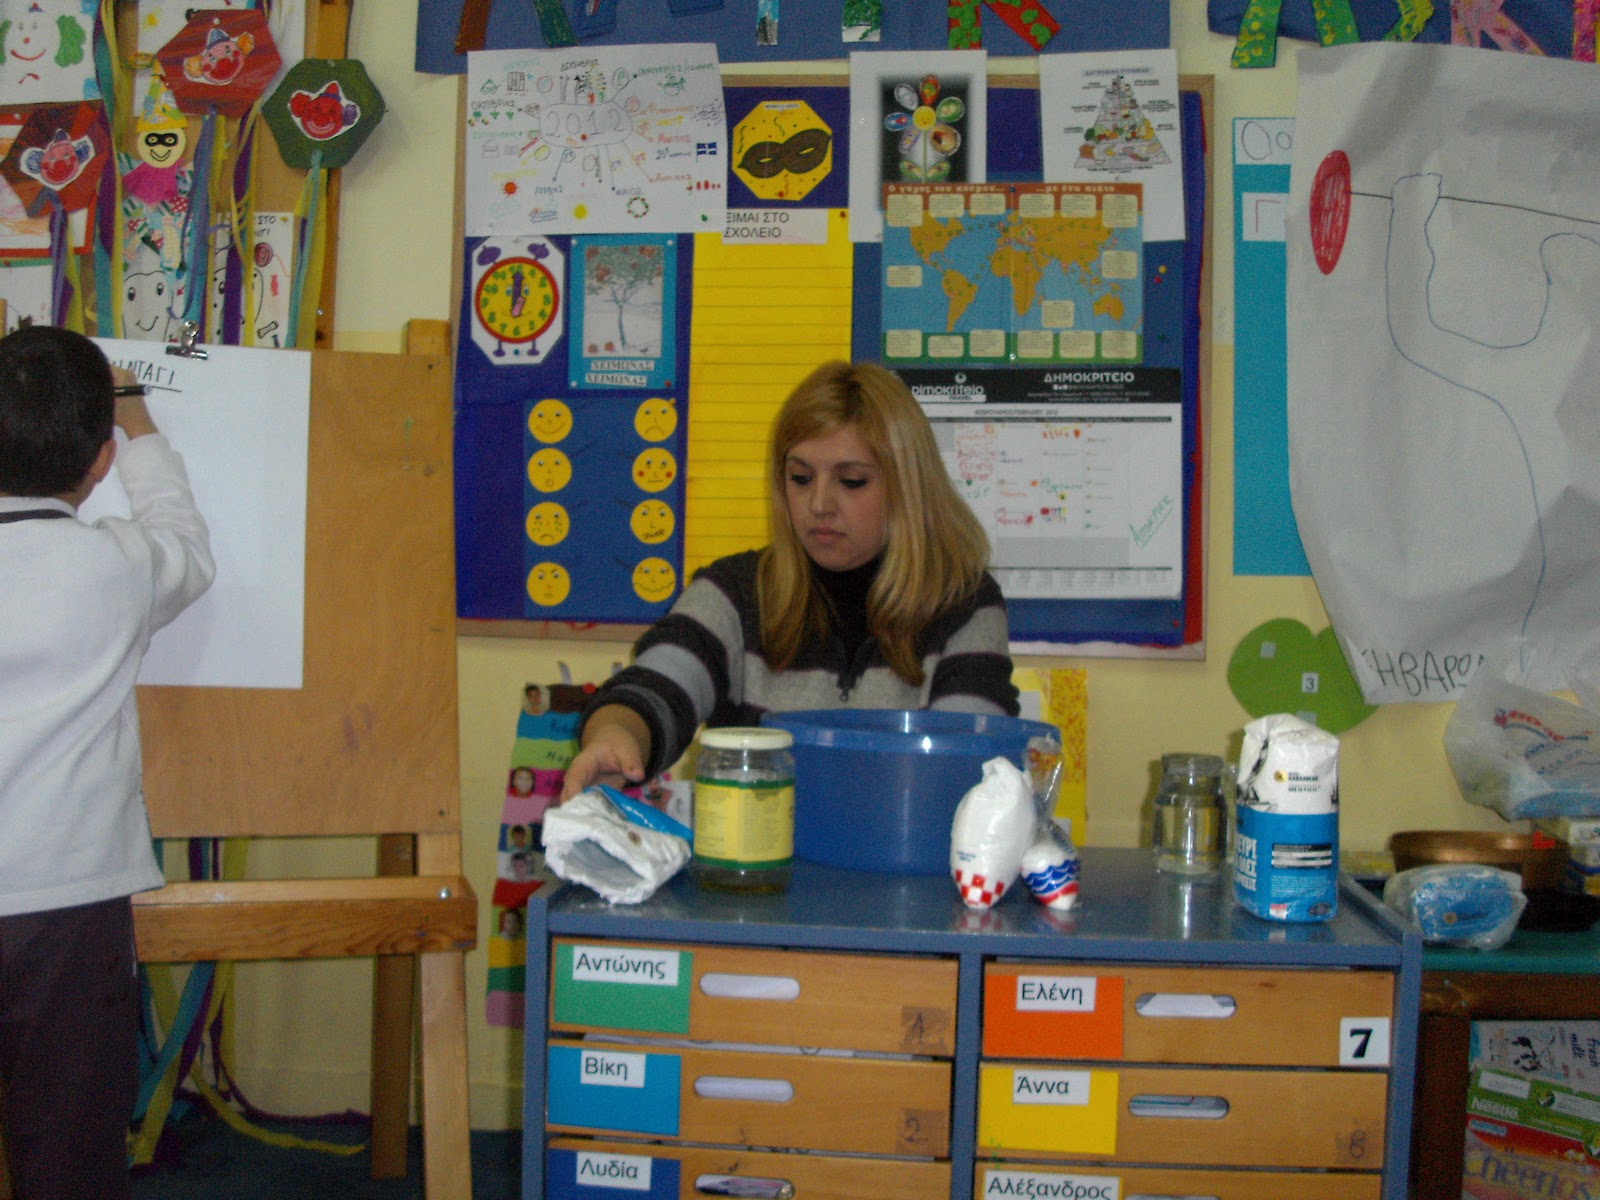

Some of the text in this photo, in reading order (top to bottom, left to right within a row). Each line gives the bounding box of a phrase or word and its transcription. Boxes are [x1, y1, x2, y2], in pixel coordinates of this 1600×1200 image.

[546, 107, 627, 137] 2012
[761, 211, 789, 225] ΣΤΟ
[724, 226, 782, 239] ΣΧΟΛΕΙΟ
[1044, 372, 1135, 383] ΔΗΜΟΚΡΙΤΕΙΟ
[1306, 677, 1315, 690] 3
[576, 952, 667, 980] Αντώνης
[1021, 981, 1084, 1006] Ελένη
[1349, 1028, 1374, 1059] 7
[584, 1056, 629, 1082] Βίκη
[1016, 1074, 1070, 1097] Άννα
[579, 1158, 639, 1182] Λυδία
[987, 1175, 1113, 1200] Αλέξανδρος
